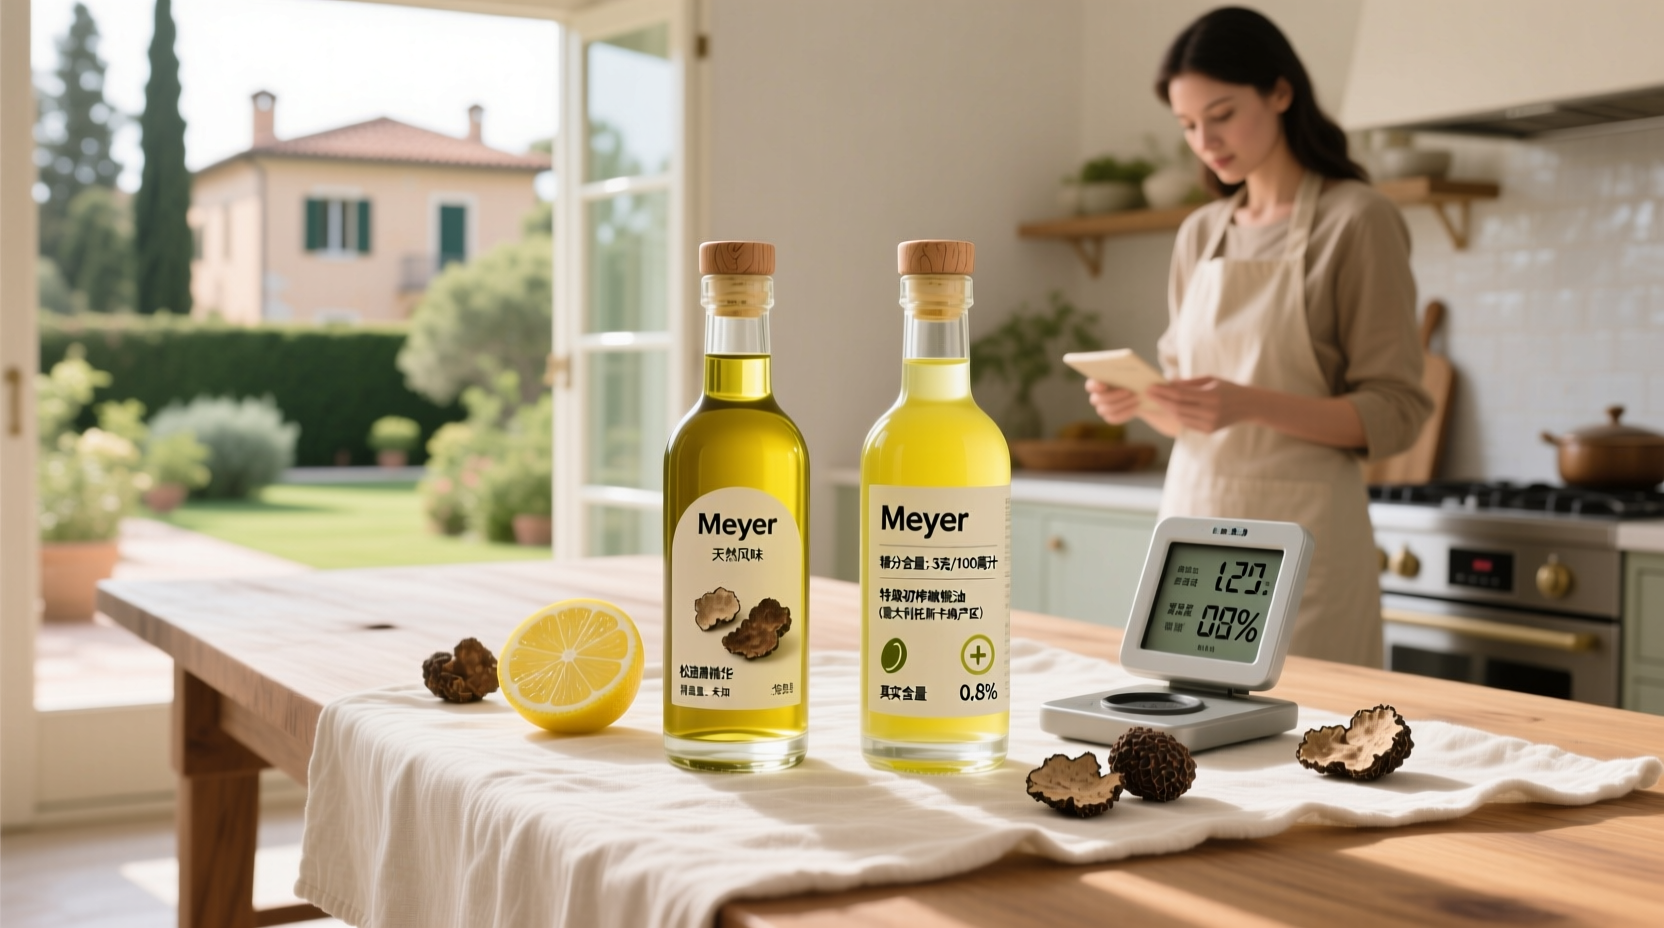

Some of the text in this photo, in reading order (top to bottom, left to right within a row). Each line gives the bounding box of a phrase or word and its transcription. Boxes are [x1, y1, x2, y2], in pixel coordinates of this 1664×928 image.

[698, 512, 778, 541] Meyer
[881, 504, 969, 539] Meyer
[712, 547, 764, 562] 天然风味
